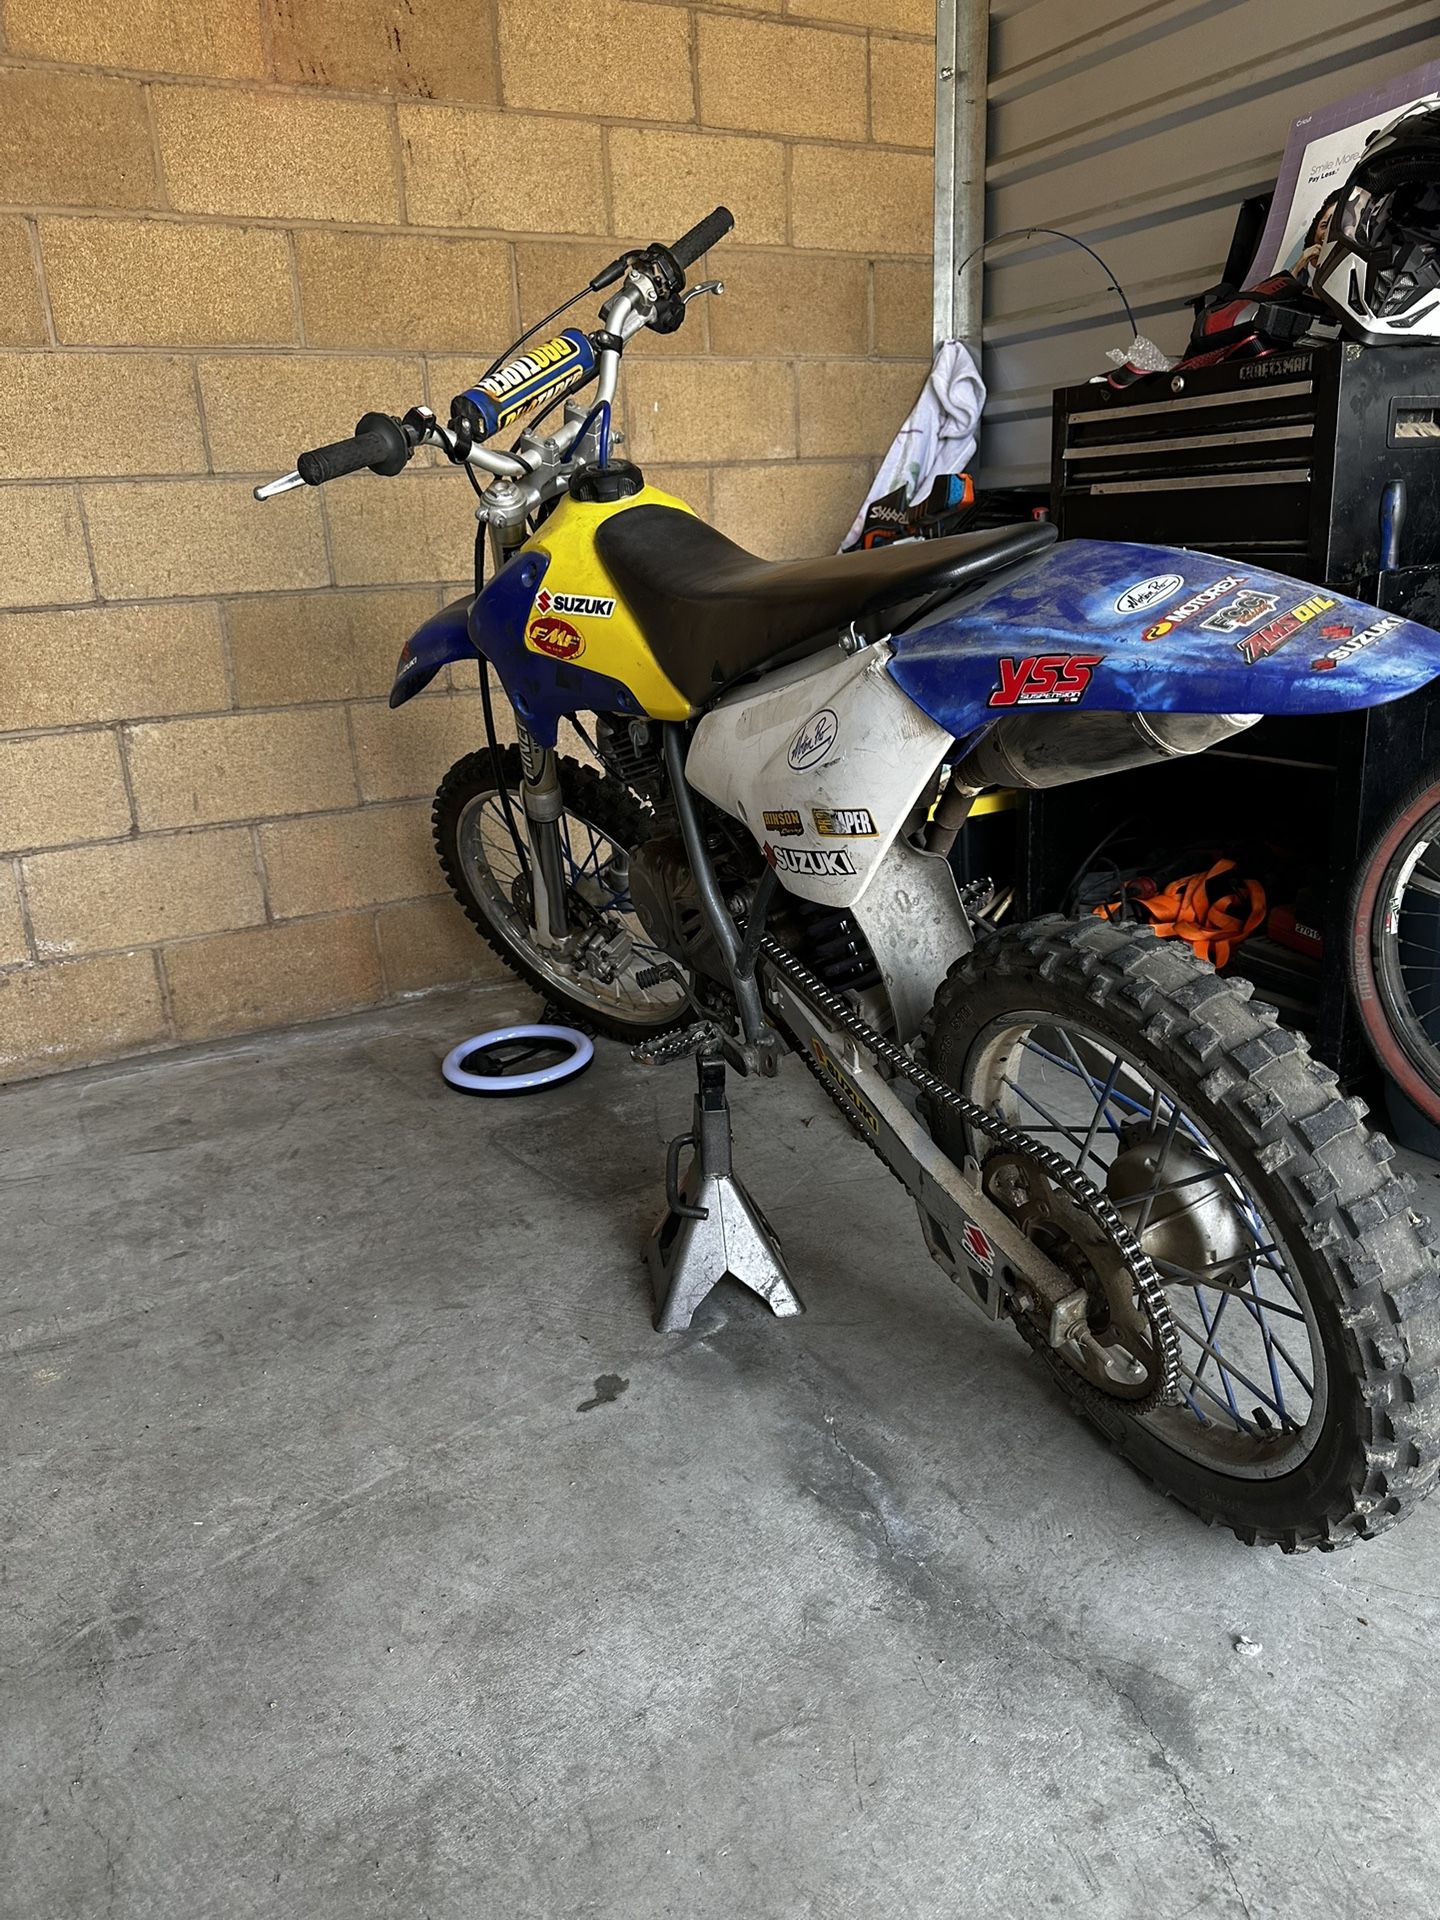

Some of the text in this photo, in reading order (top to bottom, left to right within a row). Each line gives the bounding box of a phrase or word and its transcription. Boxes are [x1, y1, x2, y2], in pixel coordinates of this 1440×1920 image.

[1308, 172, 1320, 184] Pay
[1310, 160, 1334, 176] Smile
[1239, 353, 1313, 380] CRAFTSMAN
[553, 595, 614, 616] SUZUKI
[1165, 576, 1245, 622] MOTOREX
[530, 626, 581, 648] FMF
[1242, 594, 1337, 658] AMSOIL
[1327, 617, 1406, 661] SUZUKI
[989, 655, 1103, 706] YSS
[764, 811, 799, 826] HINSON
[773, 845, 857, 876] SUZUKI
